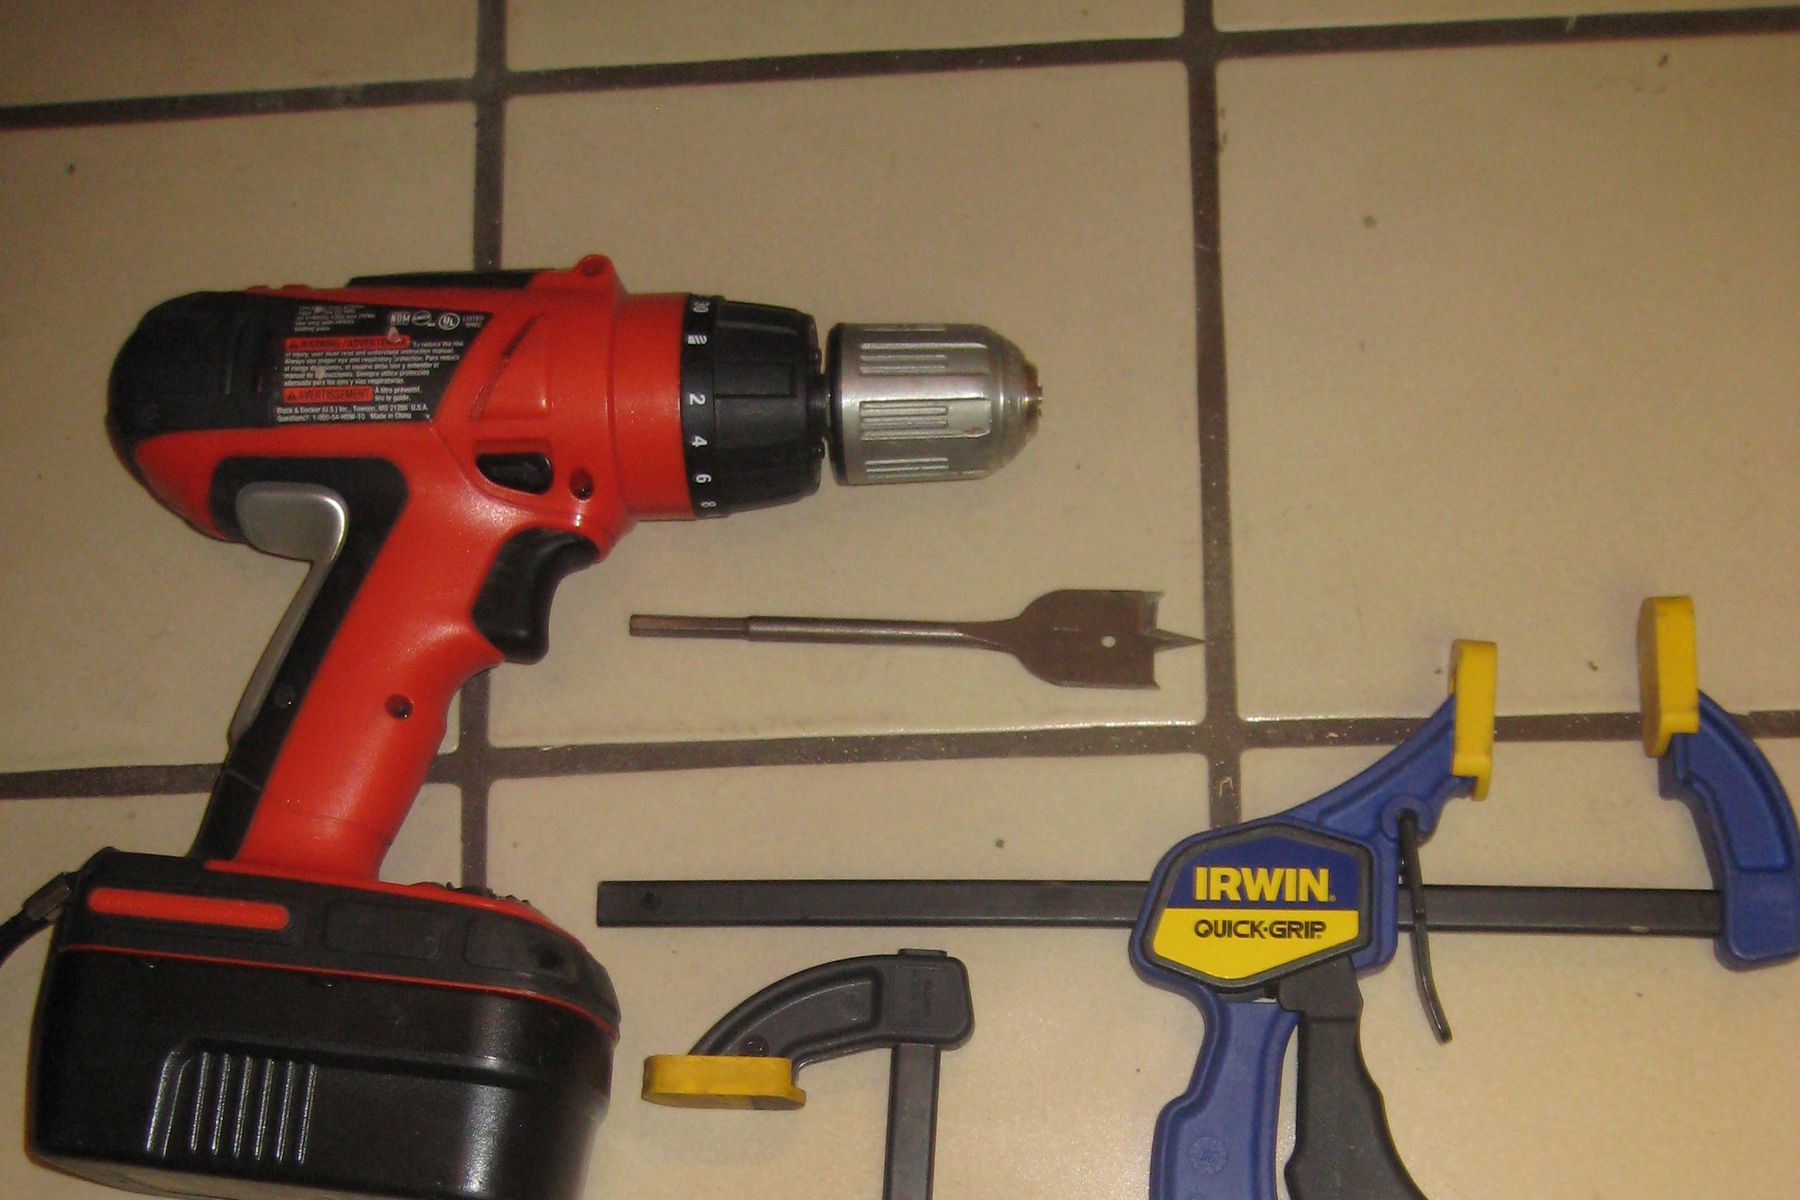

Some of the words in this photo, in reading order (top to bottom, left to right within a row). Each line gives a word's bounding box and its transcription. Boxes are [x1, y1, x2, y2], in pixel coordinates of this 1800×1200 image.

[689, 393, 706, 405] 2
[692, 435, 708, 448] 4
[695, 473, 712, 484] 6
[1194, 866, 1330, 903] IRWIN
